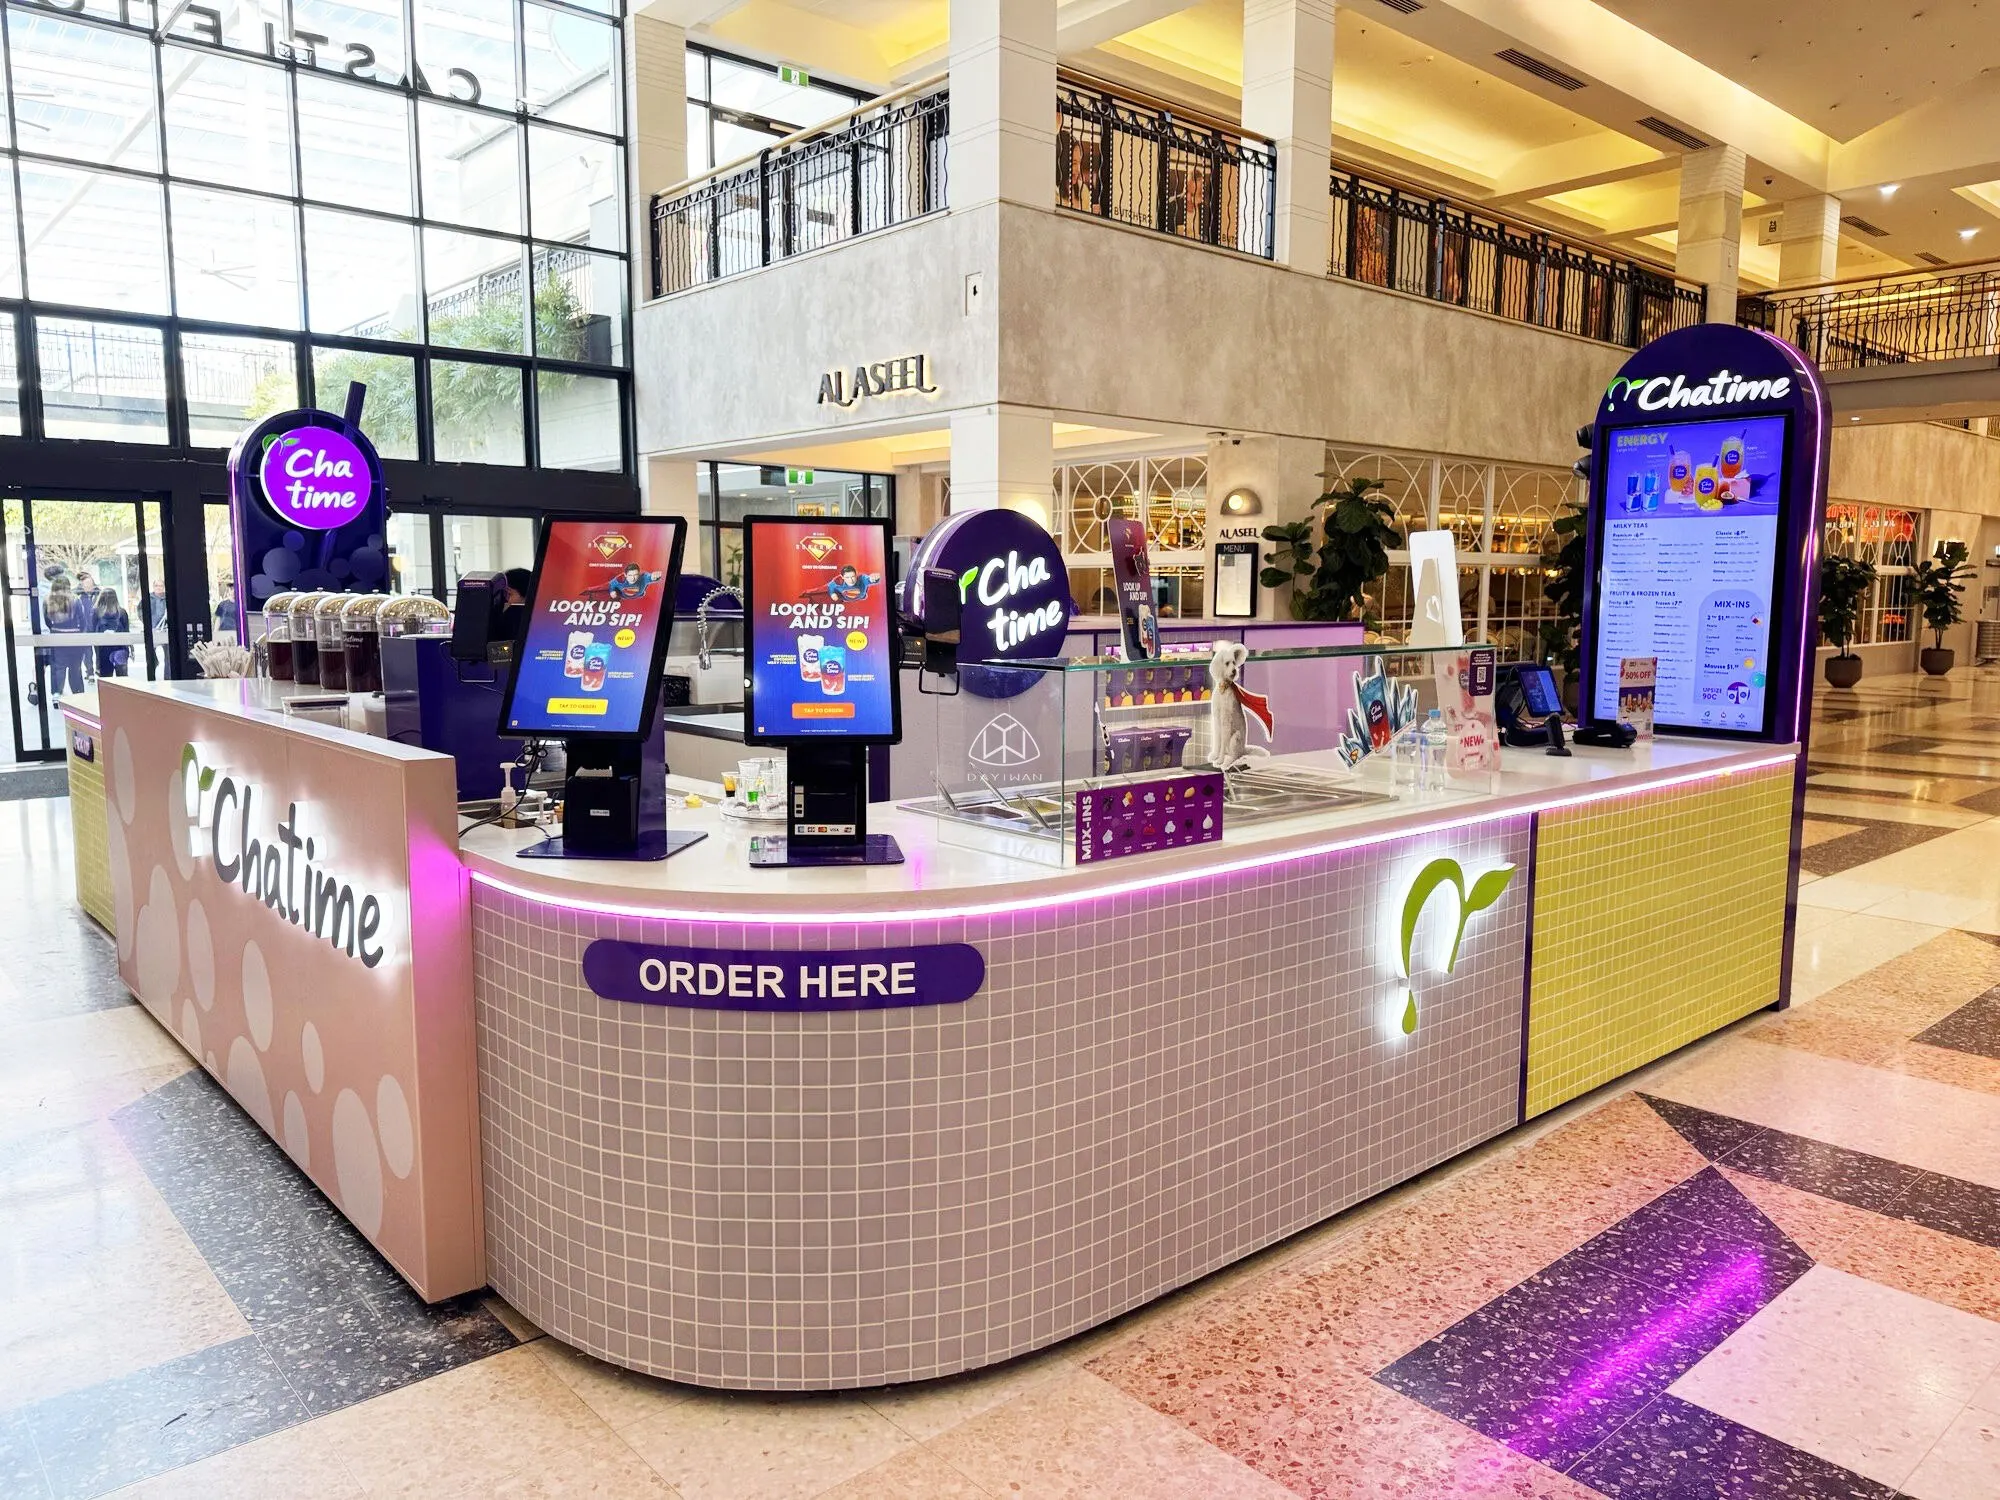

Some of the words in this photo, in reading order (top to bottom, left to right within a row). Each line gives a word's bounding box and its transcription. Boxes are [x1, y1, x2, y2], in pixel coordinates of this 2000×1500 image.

[817, 371, 853, 407] AL
[852, 354, 937, 398] ASEEL
[1638, 369, 1791, 411] Chatime
[1617, 432, 1668, 447] ENERGY
[285, 448, 354, 478] Cha
[285, 480, 356, 509] time
[1232, 527, 1260, 538] ASEEL
[978, 550, 1051, 606] Cha
[1123, 583, 1135, 591] LOOK
[549, 600, 598, 613] LOOK
[598, 601, 621, 614] UP
[770, 603, 819, 615] LOOK
[821, 603, 845, 616] UP
[564, 613, 607, 626] AND
[609, 613, 642, 626] SIP!
[789, 616, 833, 628] AND
[836, 616, 869, 628] SIP!
[987, 600, 1063, 651] time
[1625, 671, 1639, 680] 50%
[1639, 671, 1651, 679] OFF
[1463, 735, 1481, 748] NEW
[1082, 795, 1093, 860] MIX-INS
[212, 777, 384, 968] Chatime
[639, 958, 785, 998] ORDER
[800, 961, 916, 998] HERE
